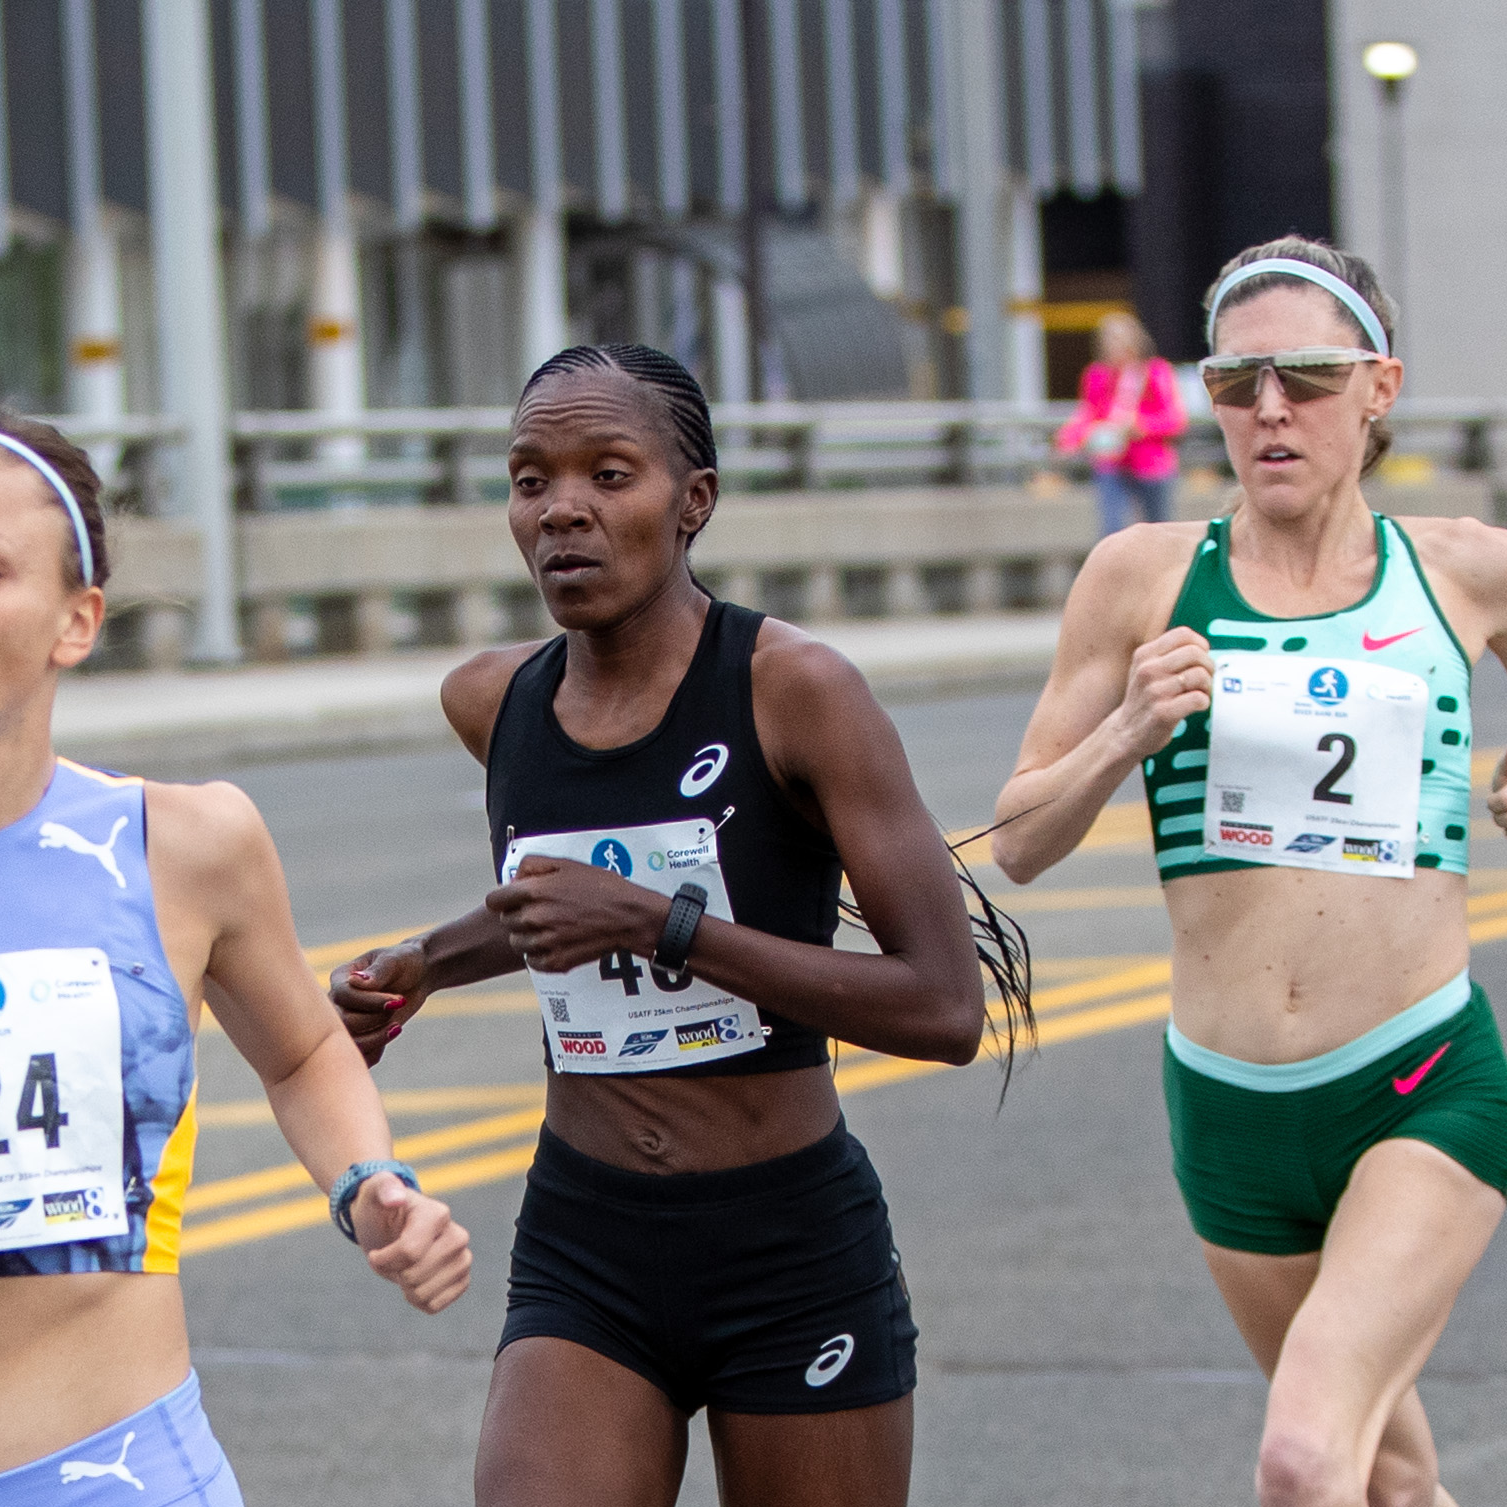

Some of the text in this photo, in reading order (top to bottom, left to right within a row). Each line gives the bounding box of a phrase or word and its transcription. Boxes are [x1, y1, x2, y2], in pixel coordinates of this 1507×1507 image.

[1312, 732, 1358, 805] 2
[1220, 829, 1273, 847] WOOD
[666, 845, 709, 859] Corewell
[668, 858, 700, 870] Health
[628, 997, 735, 1019] USATF 25km Championships
[677, 1016, 744, 1044] wood 8
[560, 1039, 607, 1055] WOOD
